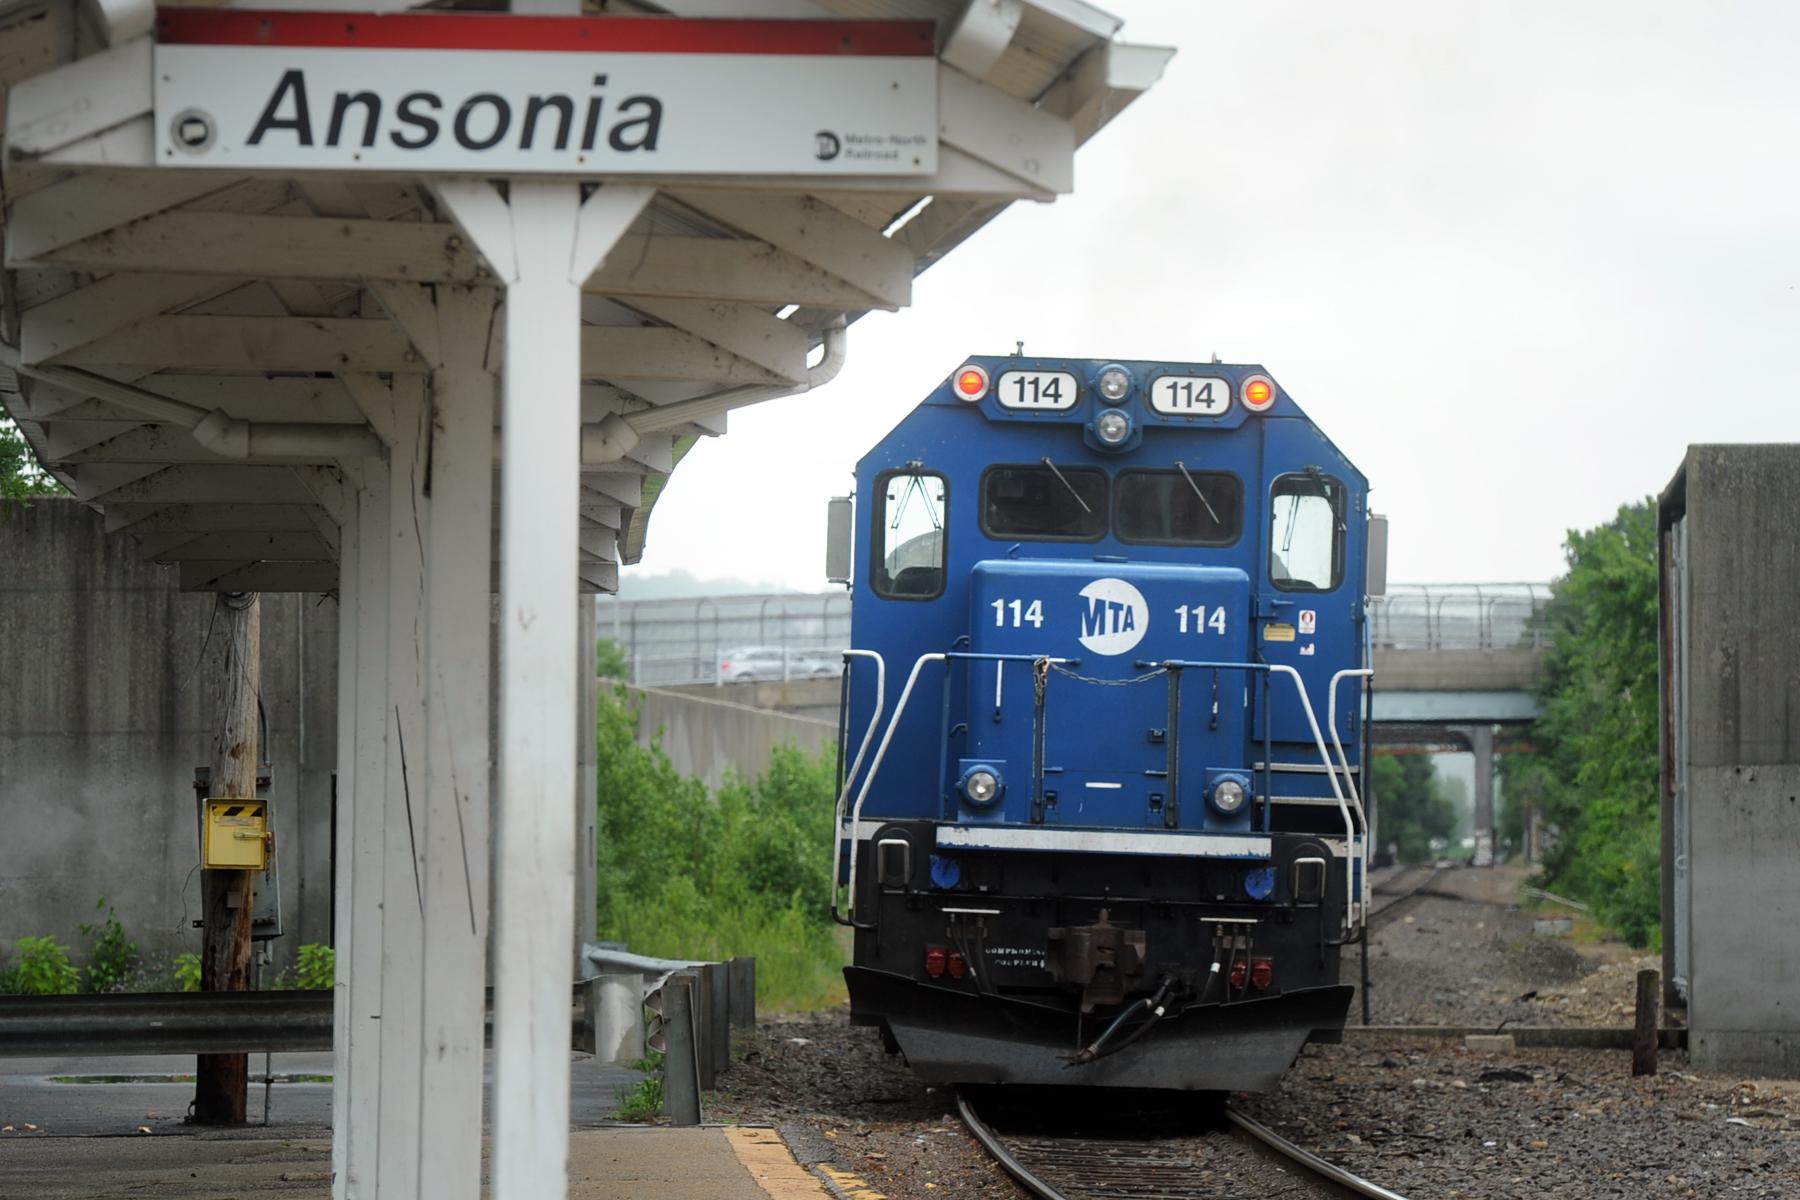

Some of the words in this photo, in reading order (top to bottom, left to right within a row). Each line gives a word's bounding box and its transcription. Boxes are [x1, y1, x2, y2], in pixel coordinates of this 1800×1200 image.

[247, 69, 664, 152] Ansonia
[1012, 376, 1063, 403] 114
[1166, 382, 1216, 408] 114
[991, 599, 1044, 628] 114
[1080, 597, 1136, 638] MTA
[1174, 605, 1226, 634] 114
